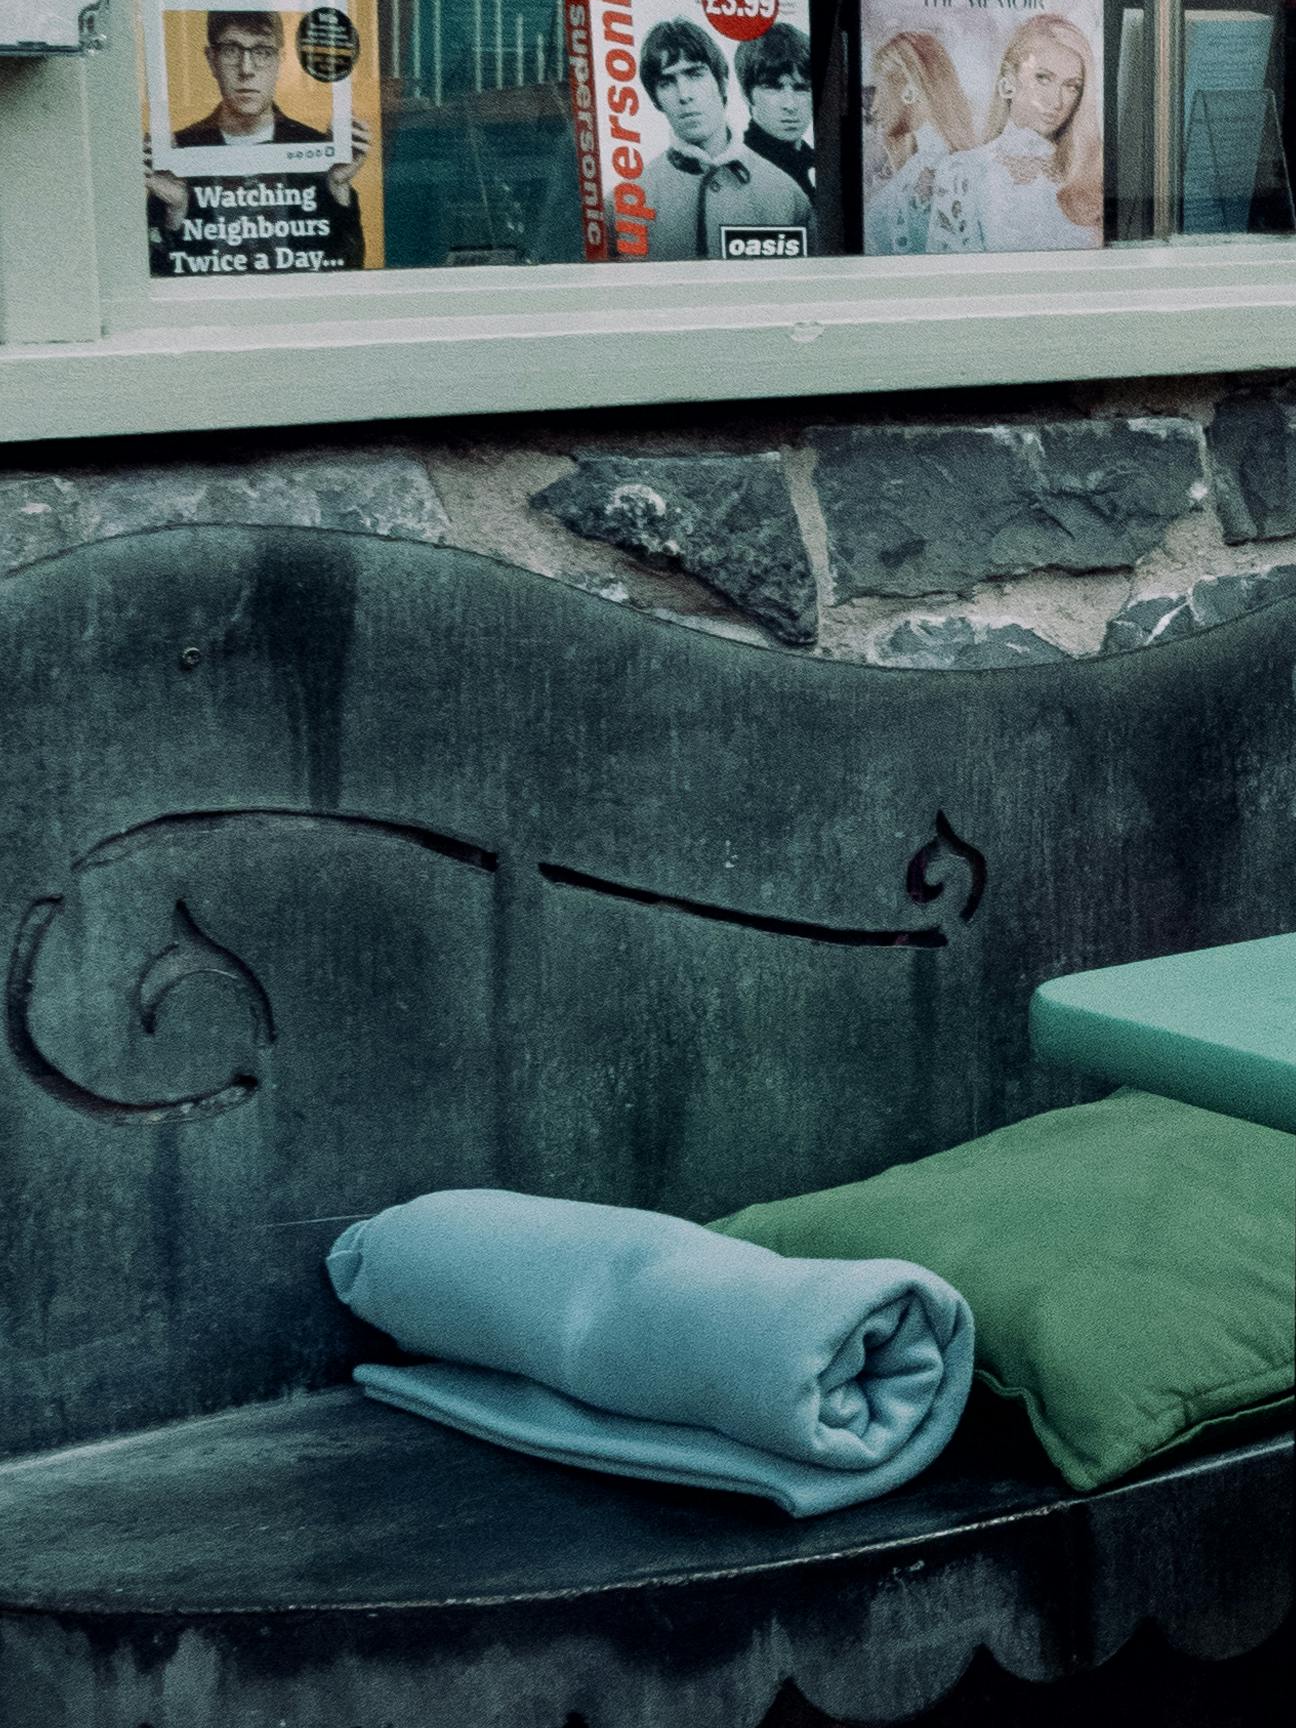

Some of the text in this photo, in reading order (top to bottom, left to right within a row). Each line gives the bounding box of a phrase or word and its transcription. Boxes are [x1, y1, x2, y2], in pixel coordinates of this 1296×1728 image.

[568, 3, 602, 246] supersonic
[194, 183, 317, 213] Watching
[182, 215, 331, 246] Neighbours
[728, 233, 800, 257] oasis
[169, 250, 345, 275] Twice a Day...
